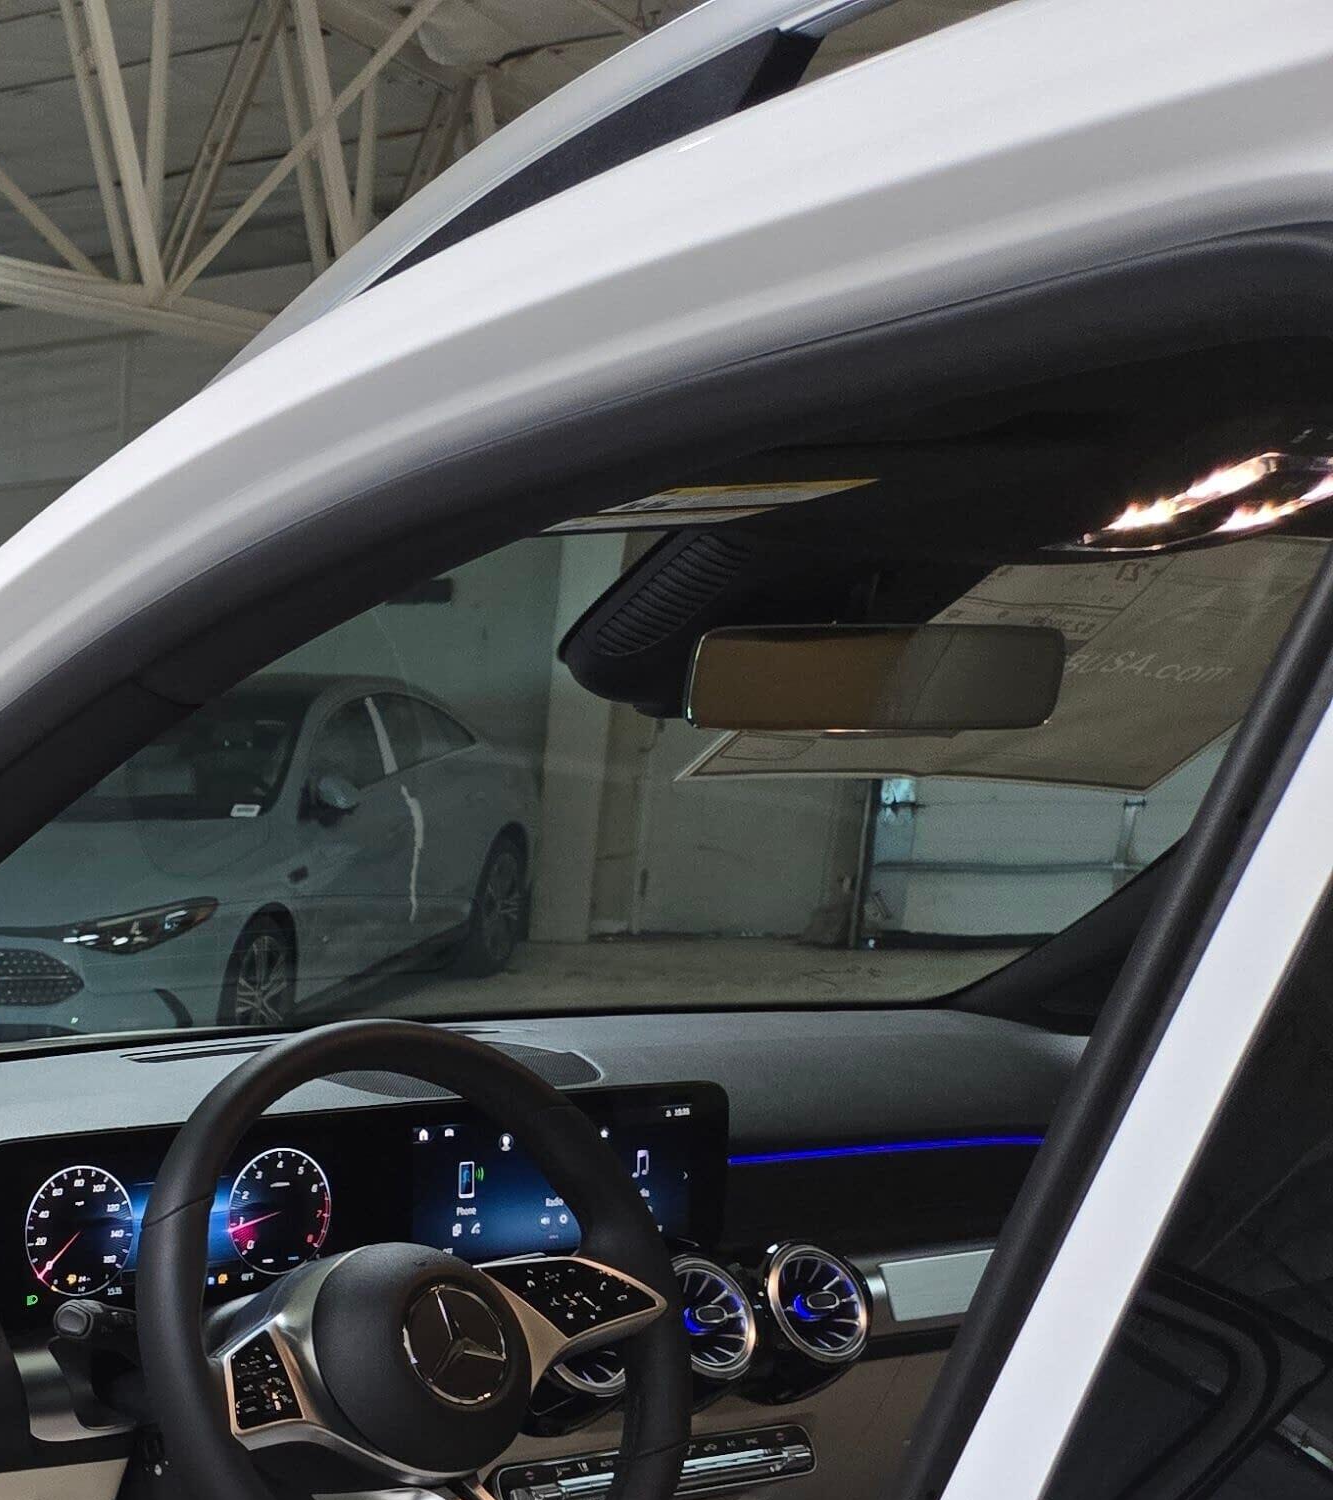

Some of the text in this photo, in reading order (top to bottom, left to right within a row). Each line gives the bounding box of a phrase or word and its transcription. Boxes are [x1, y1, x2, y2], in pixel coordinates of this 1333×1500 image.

[93, 1184, 106, 1192] 100
[456, 1206, 477, 1216] Phone
[110, 1229, 125, 1238] 140
